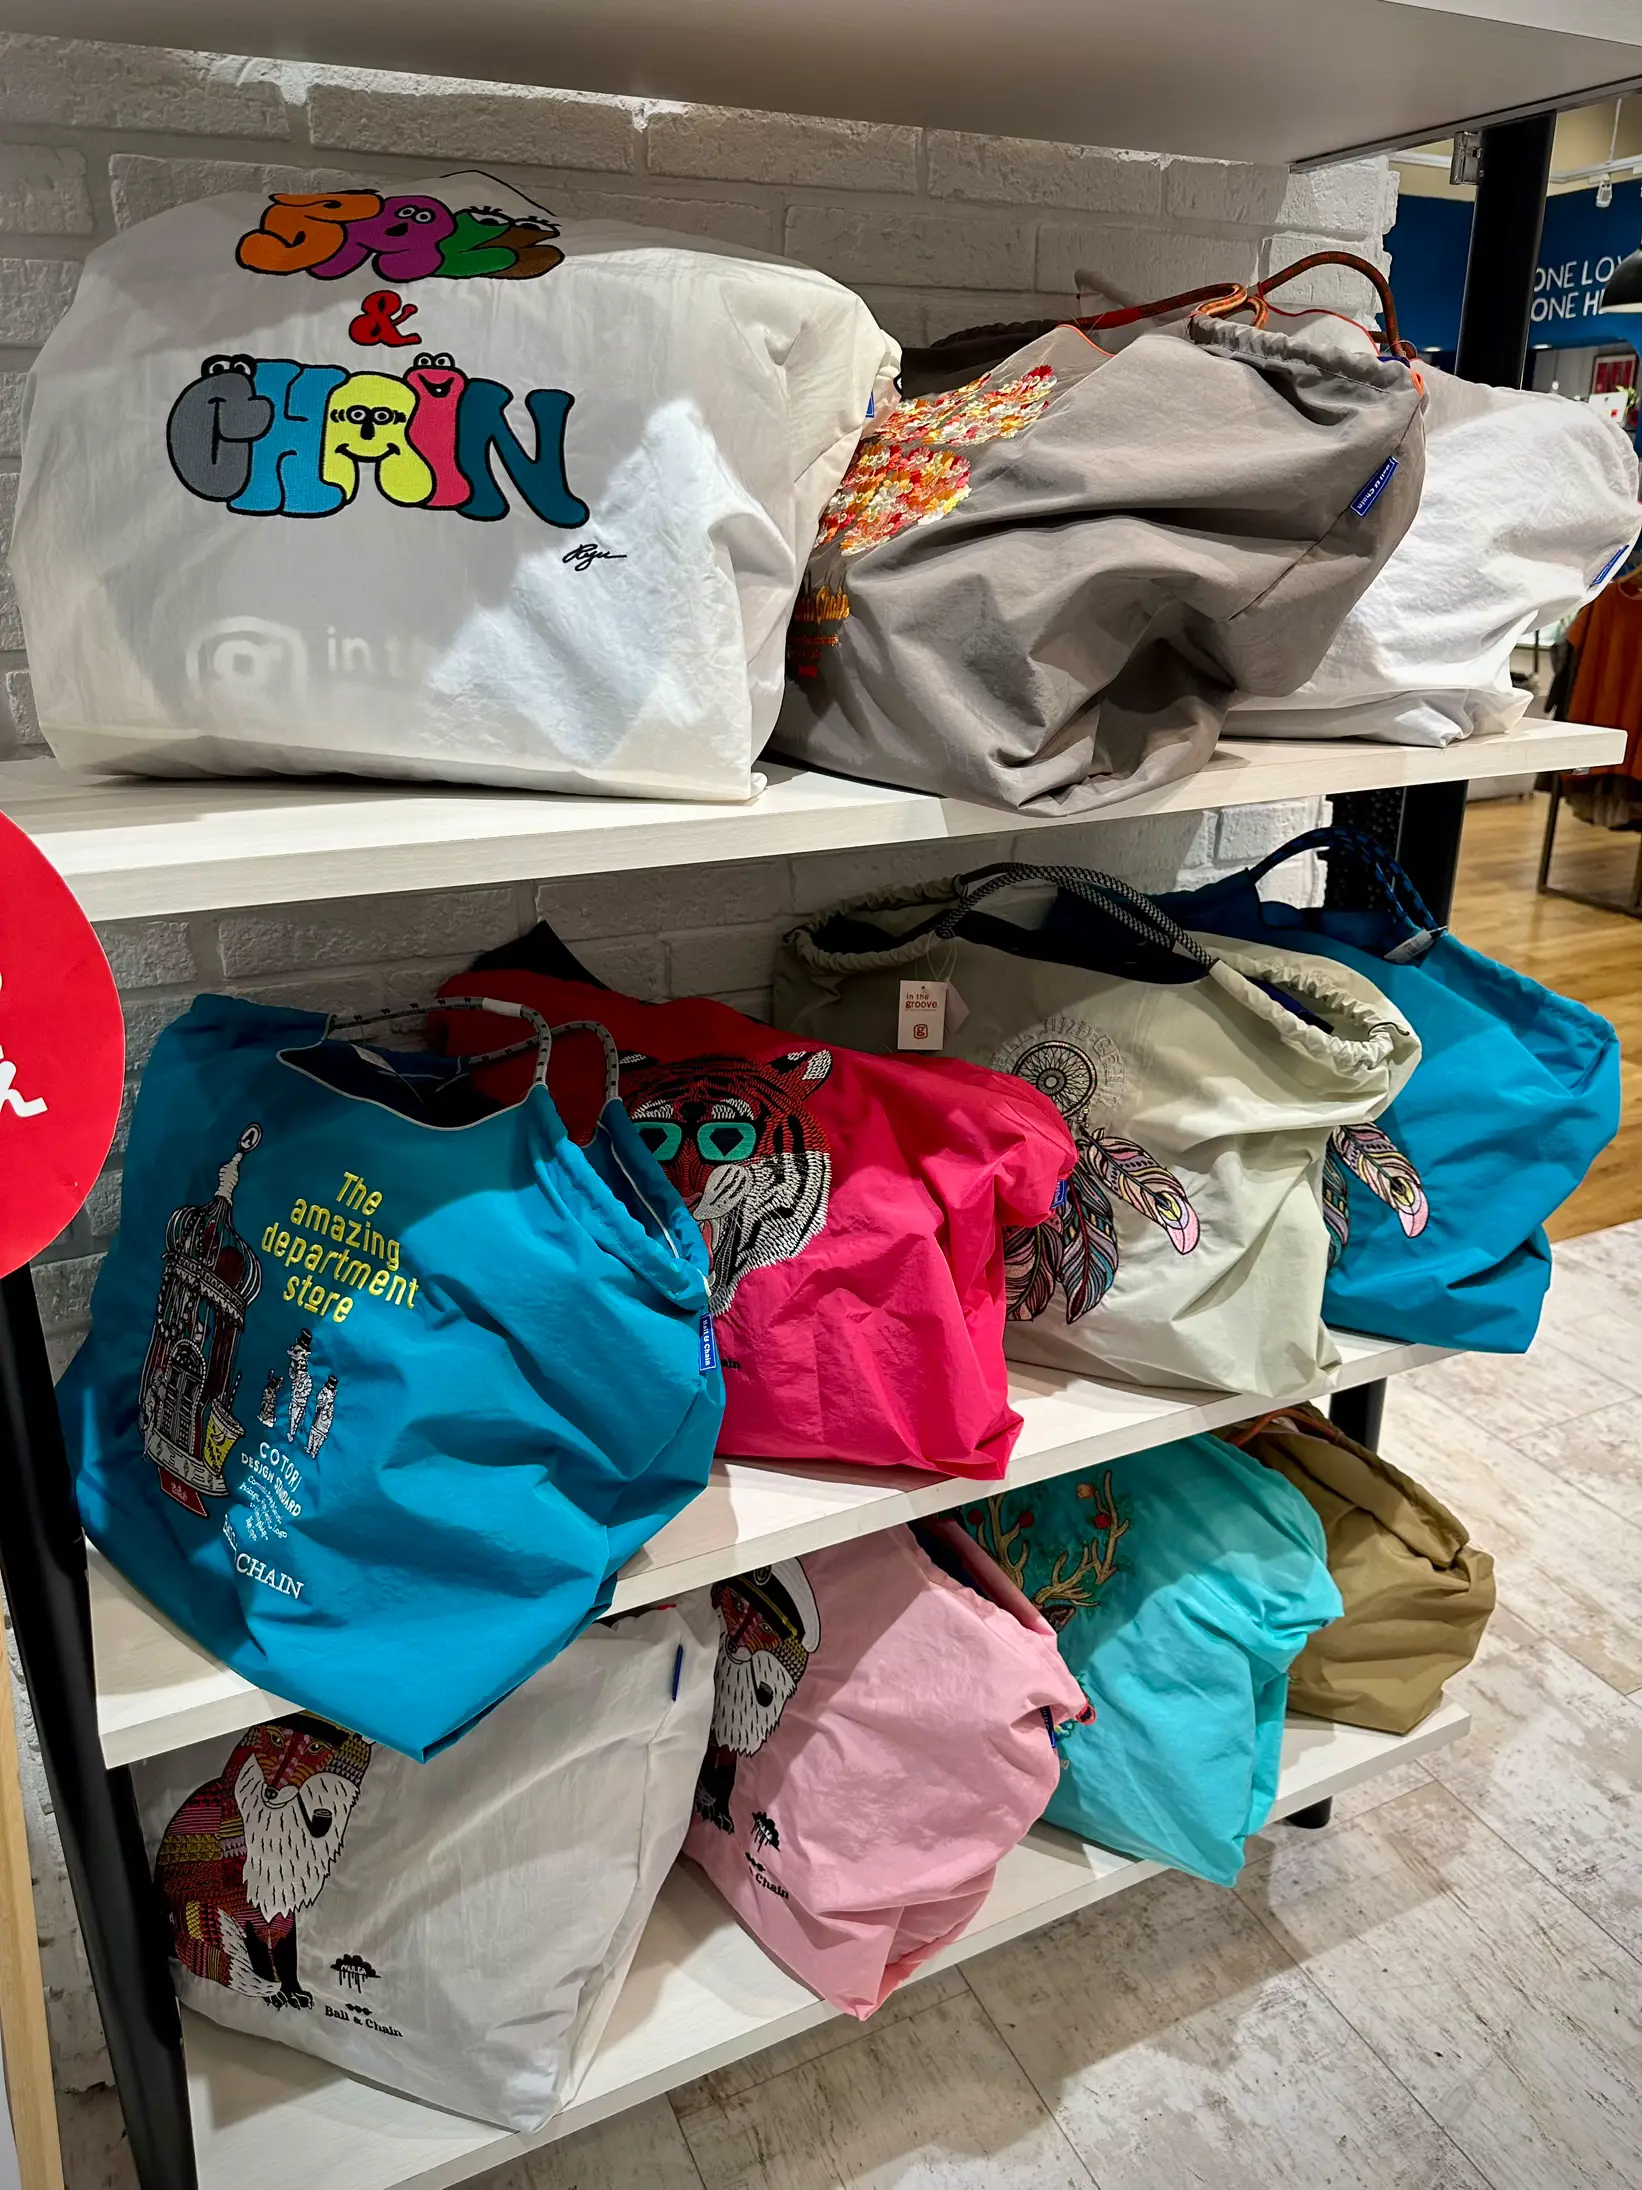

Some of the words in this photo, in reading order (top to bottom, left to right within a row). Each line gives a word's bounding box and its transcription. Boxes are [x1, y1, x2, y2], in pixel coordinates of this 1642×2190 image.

[1533, 261, 1577, 292] ONE
[1581, 256, 1622, 286] LO
[348, 289, 421, 347] &
[1530, 292, 1579, 322] ONE
[166, 353, 590, 528] CHAIN
[336, 1171, 383, 1216] The
[290, 1198, 400, 1271] amazing
[261, 1222, 419, 1310] department
[283, 1275, 354, 1323] store
[241, 1452, 275, 1484] DESIGN
[260, 1441, 303, 1493] COTORI
[236, 1552, 304, 1599] CHAIN
[324, 2004, 350, 2021] Ball
[353, 2016, 363, 2026] &
[365, 2018, 404, 2037] Chain
